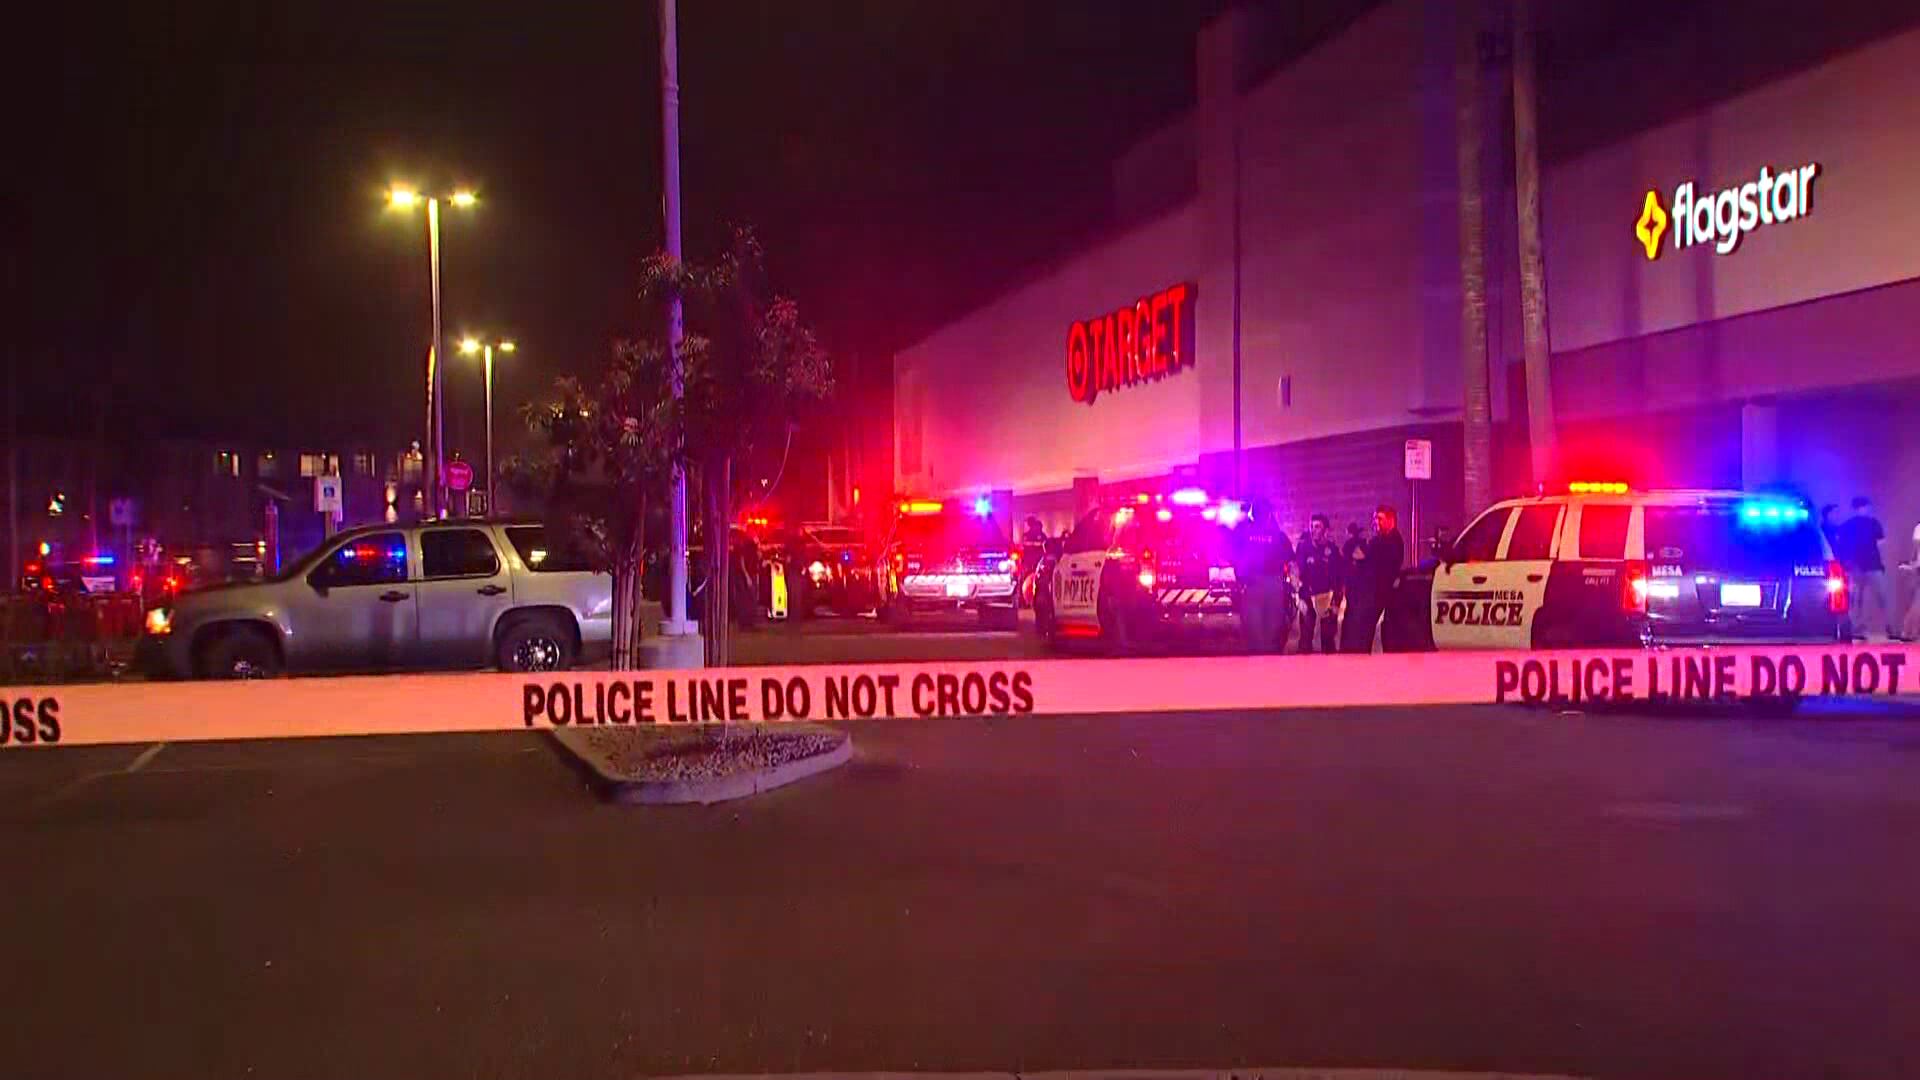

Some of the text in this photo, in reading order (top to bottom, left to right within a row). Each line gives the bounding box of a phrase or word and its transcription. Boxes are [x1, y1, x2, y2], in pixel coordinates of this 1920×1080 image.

[1672, 162, 1816, 255] flagstar
[1089, 284, 1187, 391] TARGET
[1652, 564, 1683, 577] MESA
[1794, 565, 1825, 577] POLICE
[1063, 578, 1095, 603] POLICE
[1494, 590, 1524, 600] MESA
[1435, 601, 1524, 626] POLICE
[1495, 652, 1907, 704] POLICE LINE DO NOT
[523, 671, 1034, 726] POLICE LINE DO NOT CROSS
